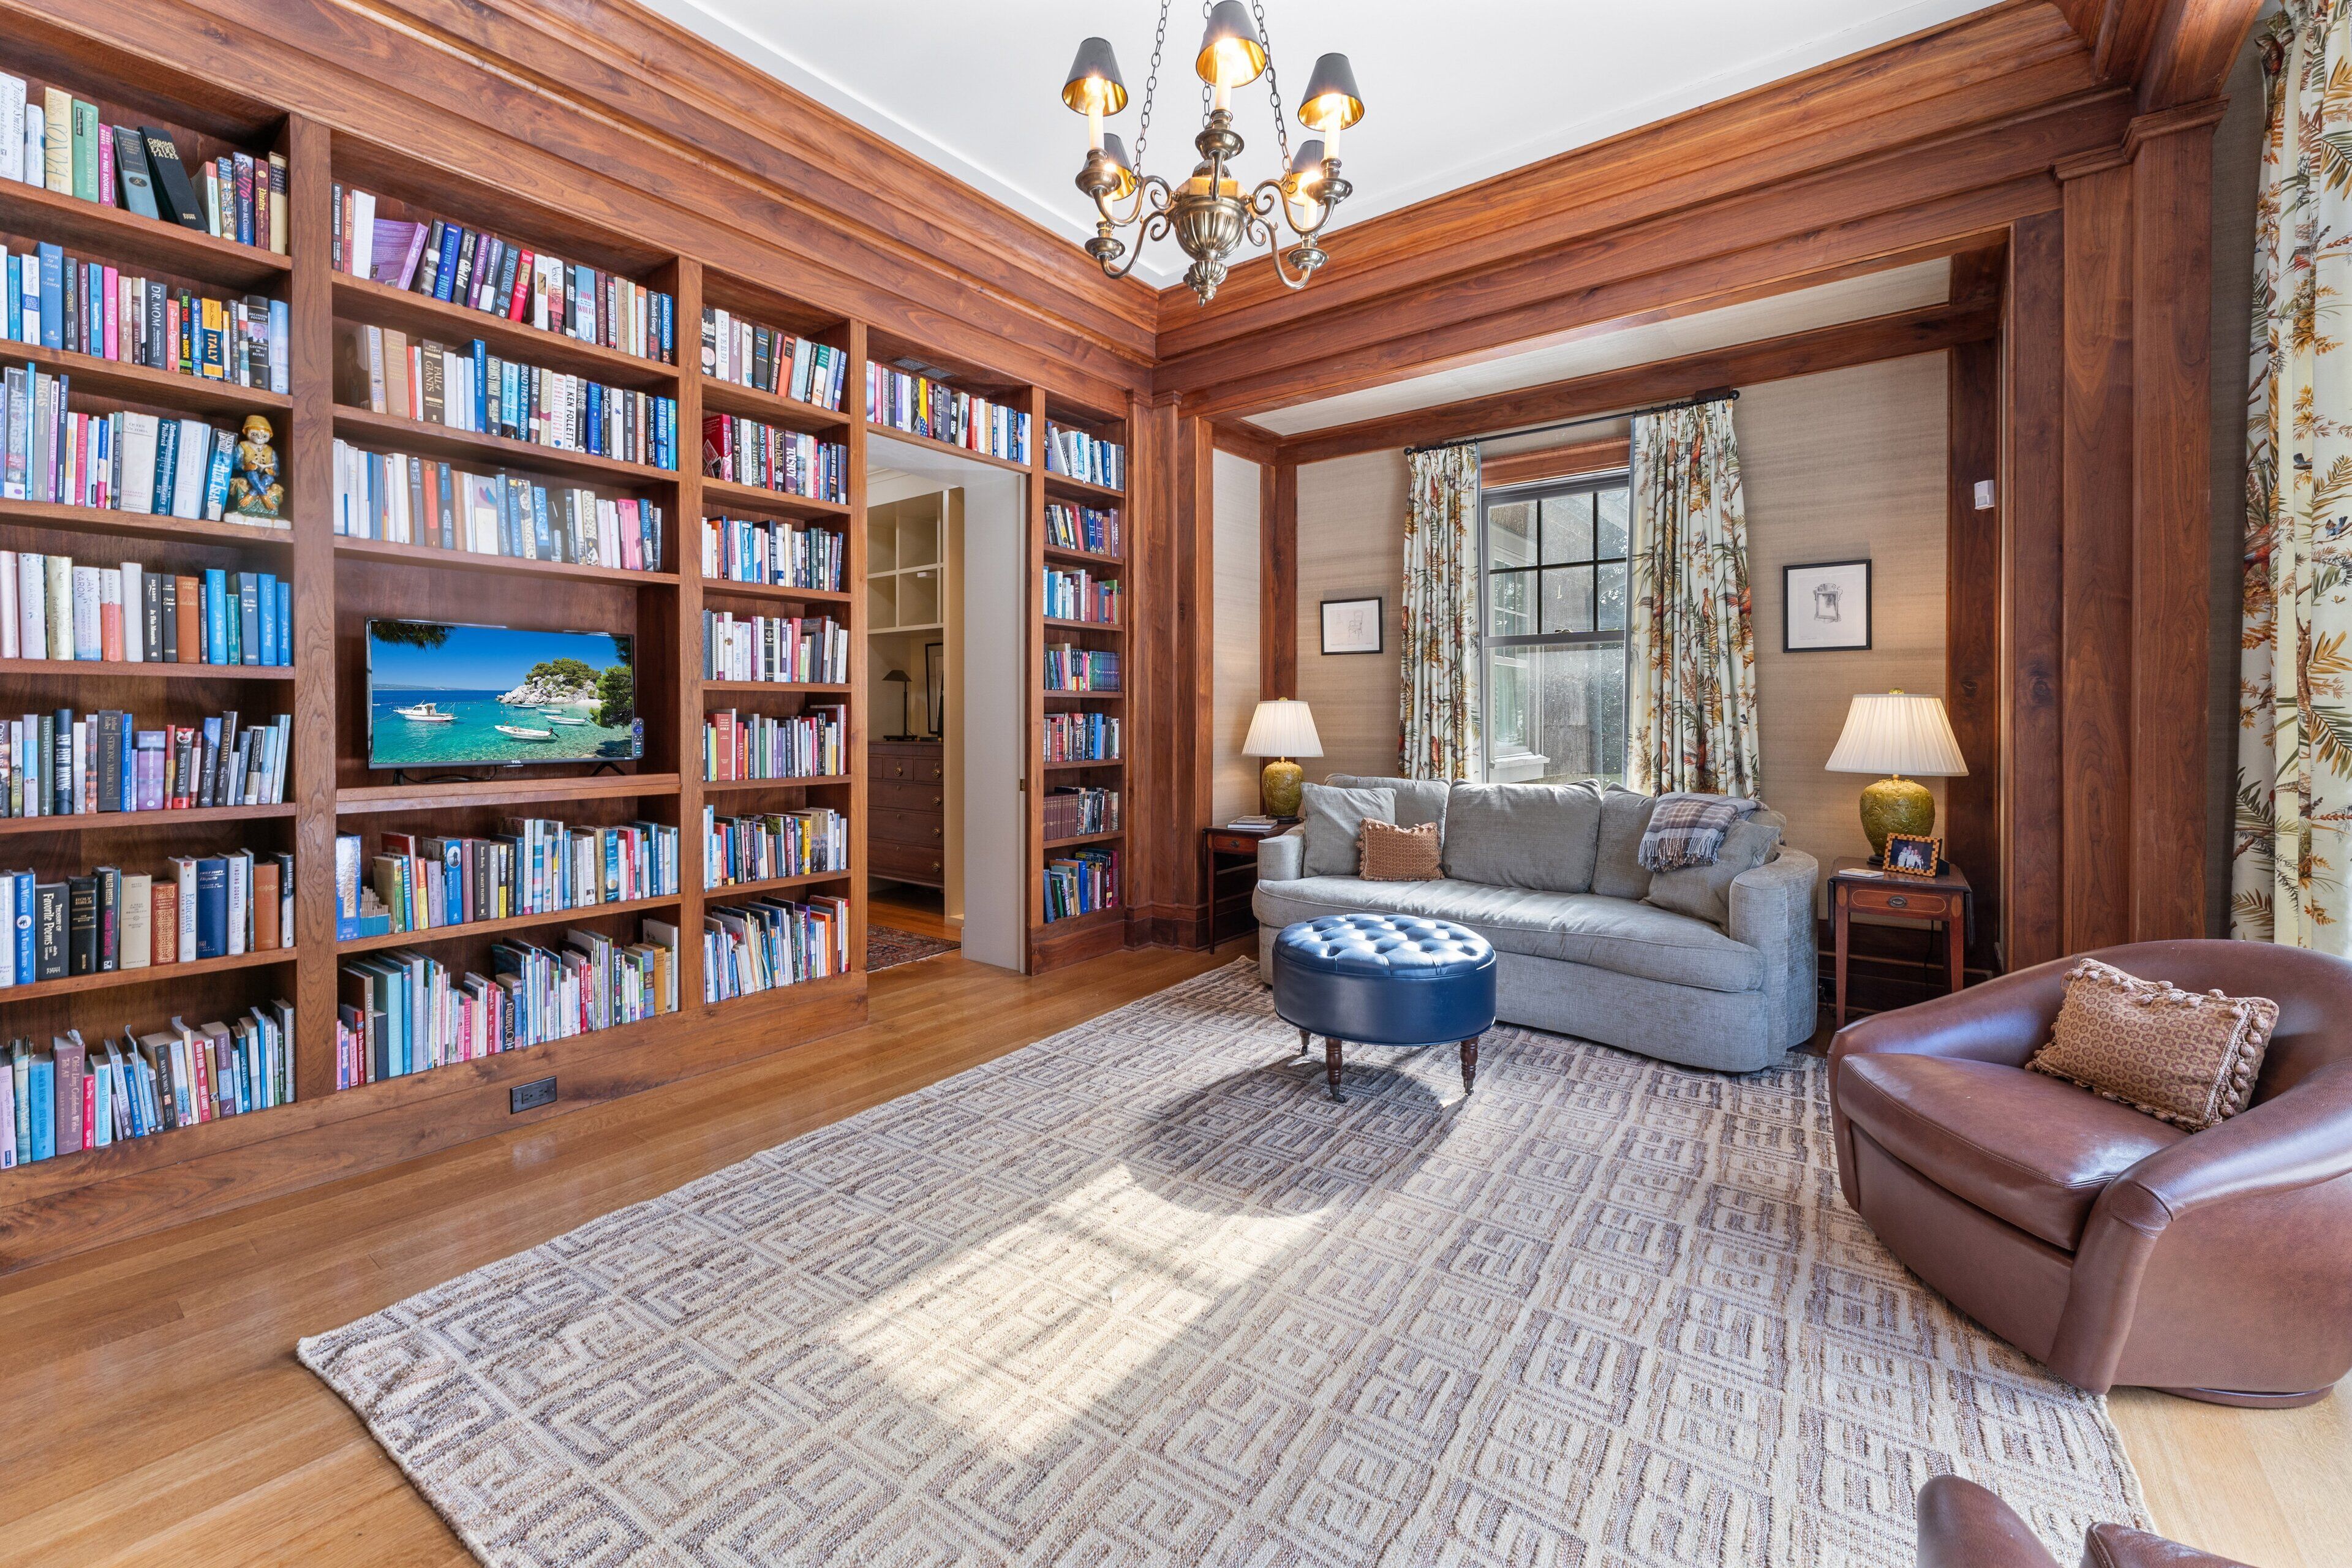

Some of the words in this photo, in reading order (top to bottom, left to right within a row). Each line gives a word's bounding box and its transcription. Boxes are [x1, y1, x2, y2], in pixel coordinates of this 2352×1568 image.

[11, 82, 24, 110] Joseph
[13, 111, 24, 134] Smith
[46, 117, 69, 178] SONYA
[237, 177, 252, 202] 1776
[257, 187, 266, 211] Pirates
[478, 235, 488, 255] ADRIANA
[508, 248, 518, 257] THE
[505, 258, 516, 270] FIRST
[551, 264, 560, 282] Nelson
[151, 286, 160, 300] DR.
[501, 271, 513, 293] COUNSEL
[152, 302, 160, 326] MOM
[208, 333, 217, 361] ITALY
[371, 328, 380, 347] DAVID
[426, 361, 434, 391] GIANTS
[37, 379, 48, 407] DEGAS
[488, 380, 500, 396] TORCH
[225, 435, 234, 454] NELSON
[786, 447, 797, 480] TOLSTOY
[56, 734, 71, 745] NEW
[221, 733, 230, 761] GRAHAM
[56, 748, 71, 764] EVERY
[56, 766, 71, 790] MORNING
[43, 893, 54, 921] Favorite
[186, 894, 194, 933] Educated
[43, 922, 54, 945] Poems
[99, 1093, 108, 1112] Tiffany
